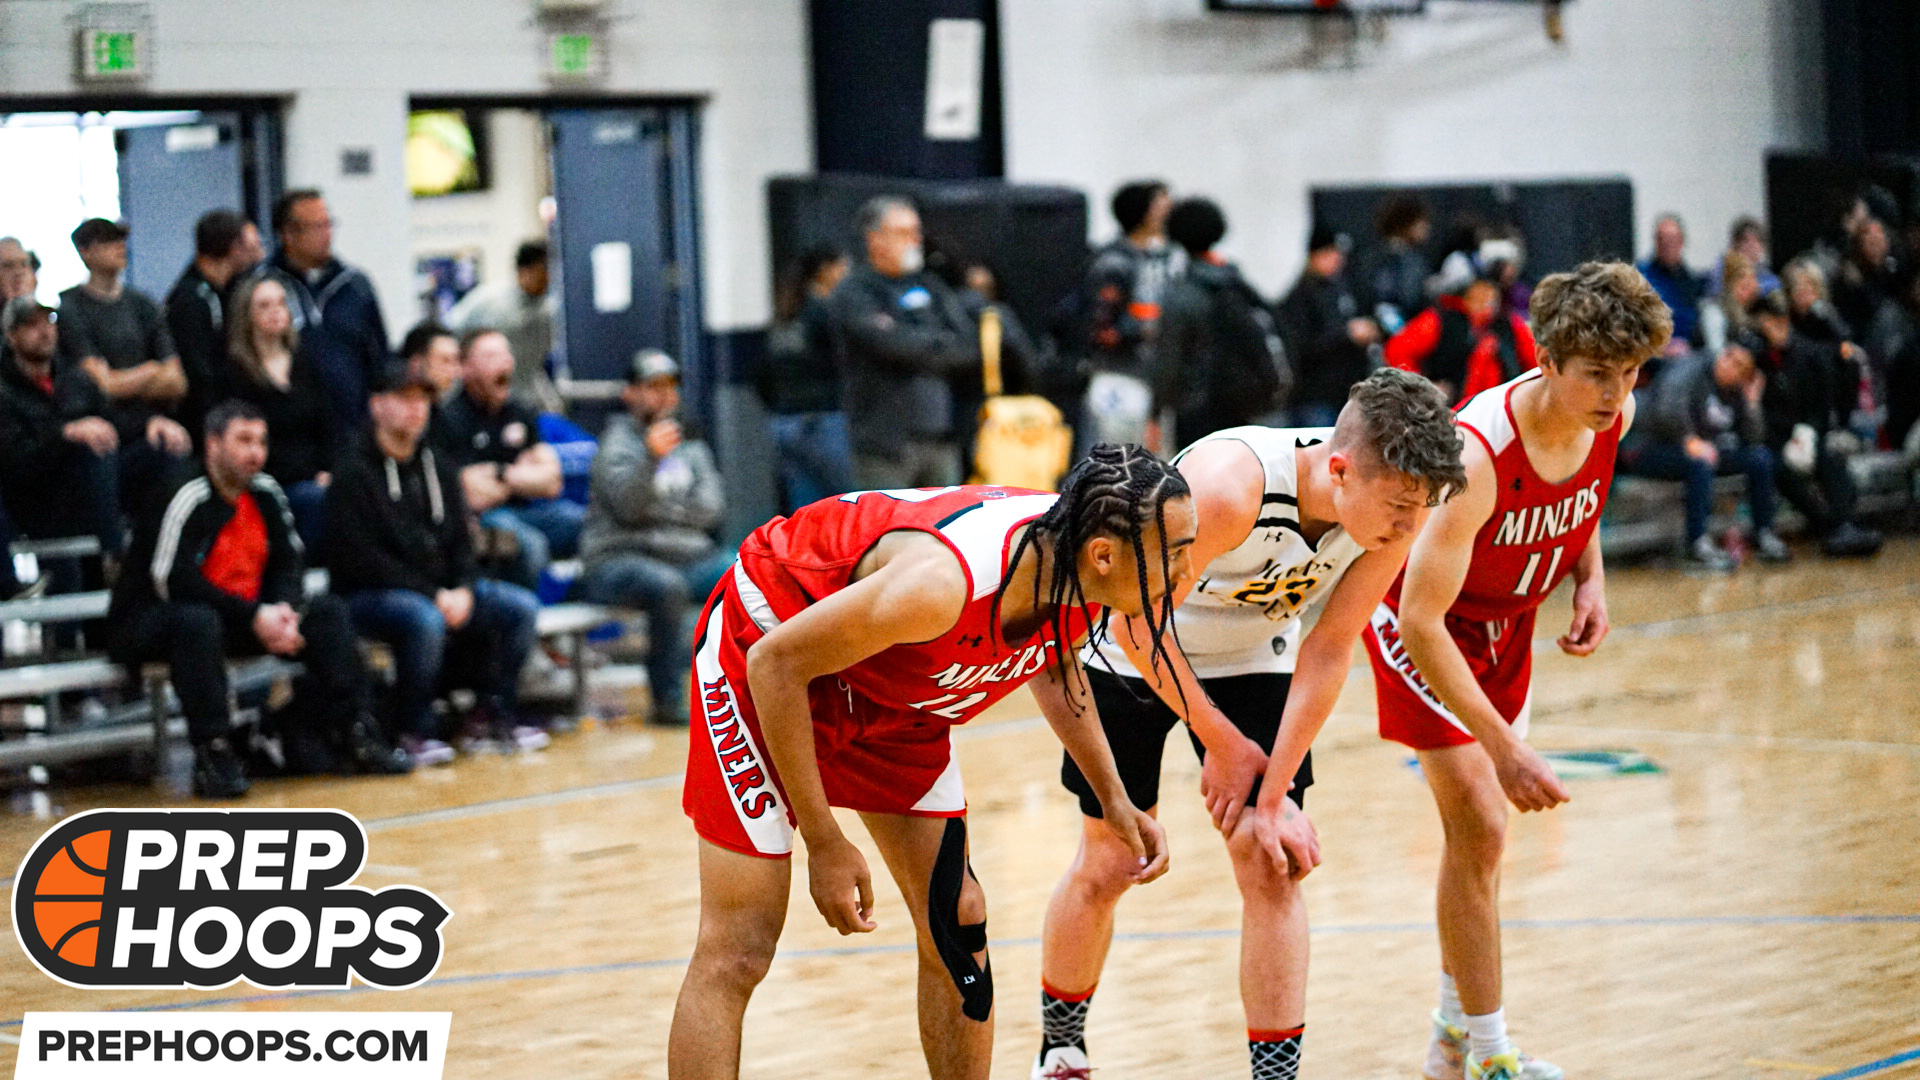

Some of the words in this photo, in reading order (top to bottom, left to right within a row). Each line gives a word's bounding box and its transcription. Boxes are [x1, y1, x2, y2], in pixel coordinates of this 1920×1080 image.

[1493, 478, 1600, 546] MINERS
[1511, 545, 1565, 596] 11
[928, 640, 1056, 690] MINERS
[906, 691, 989, 719] 12
[704, 675, 776, 819] MINERS
